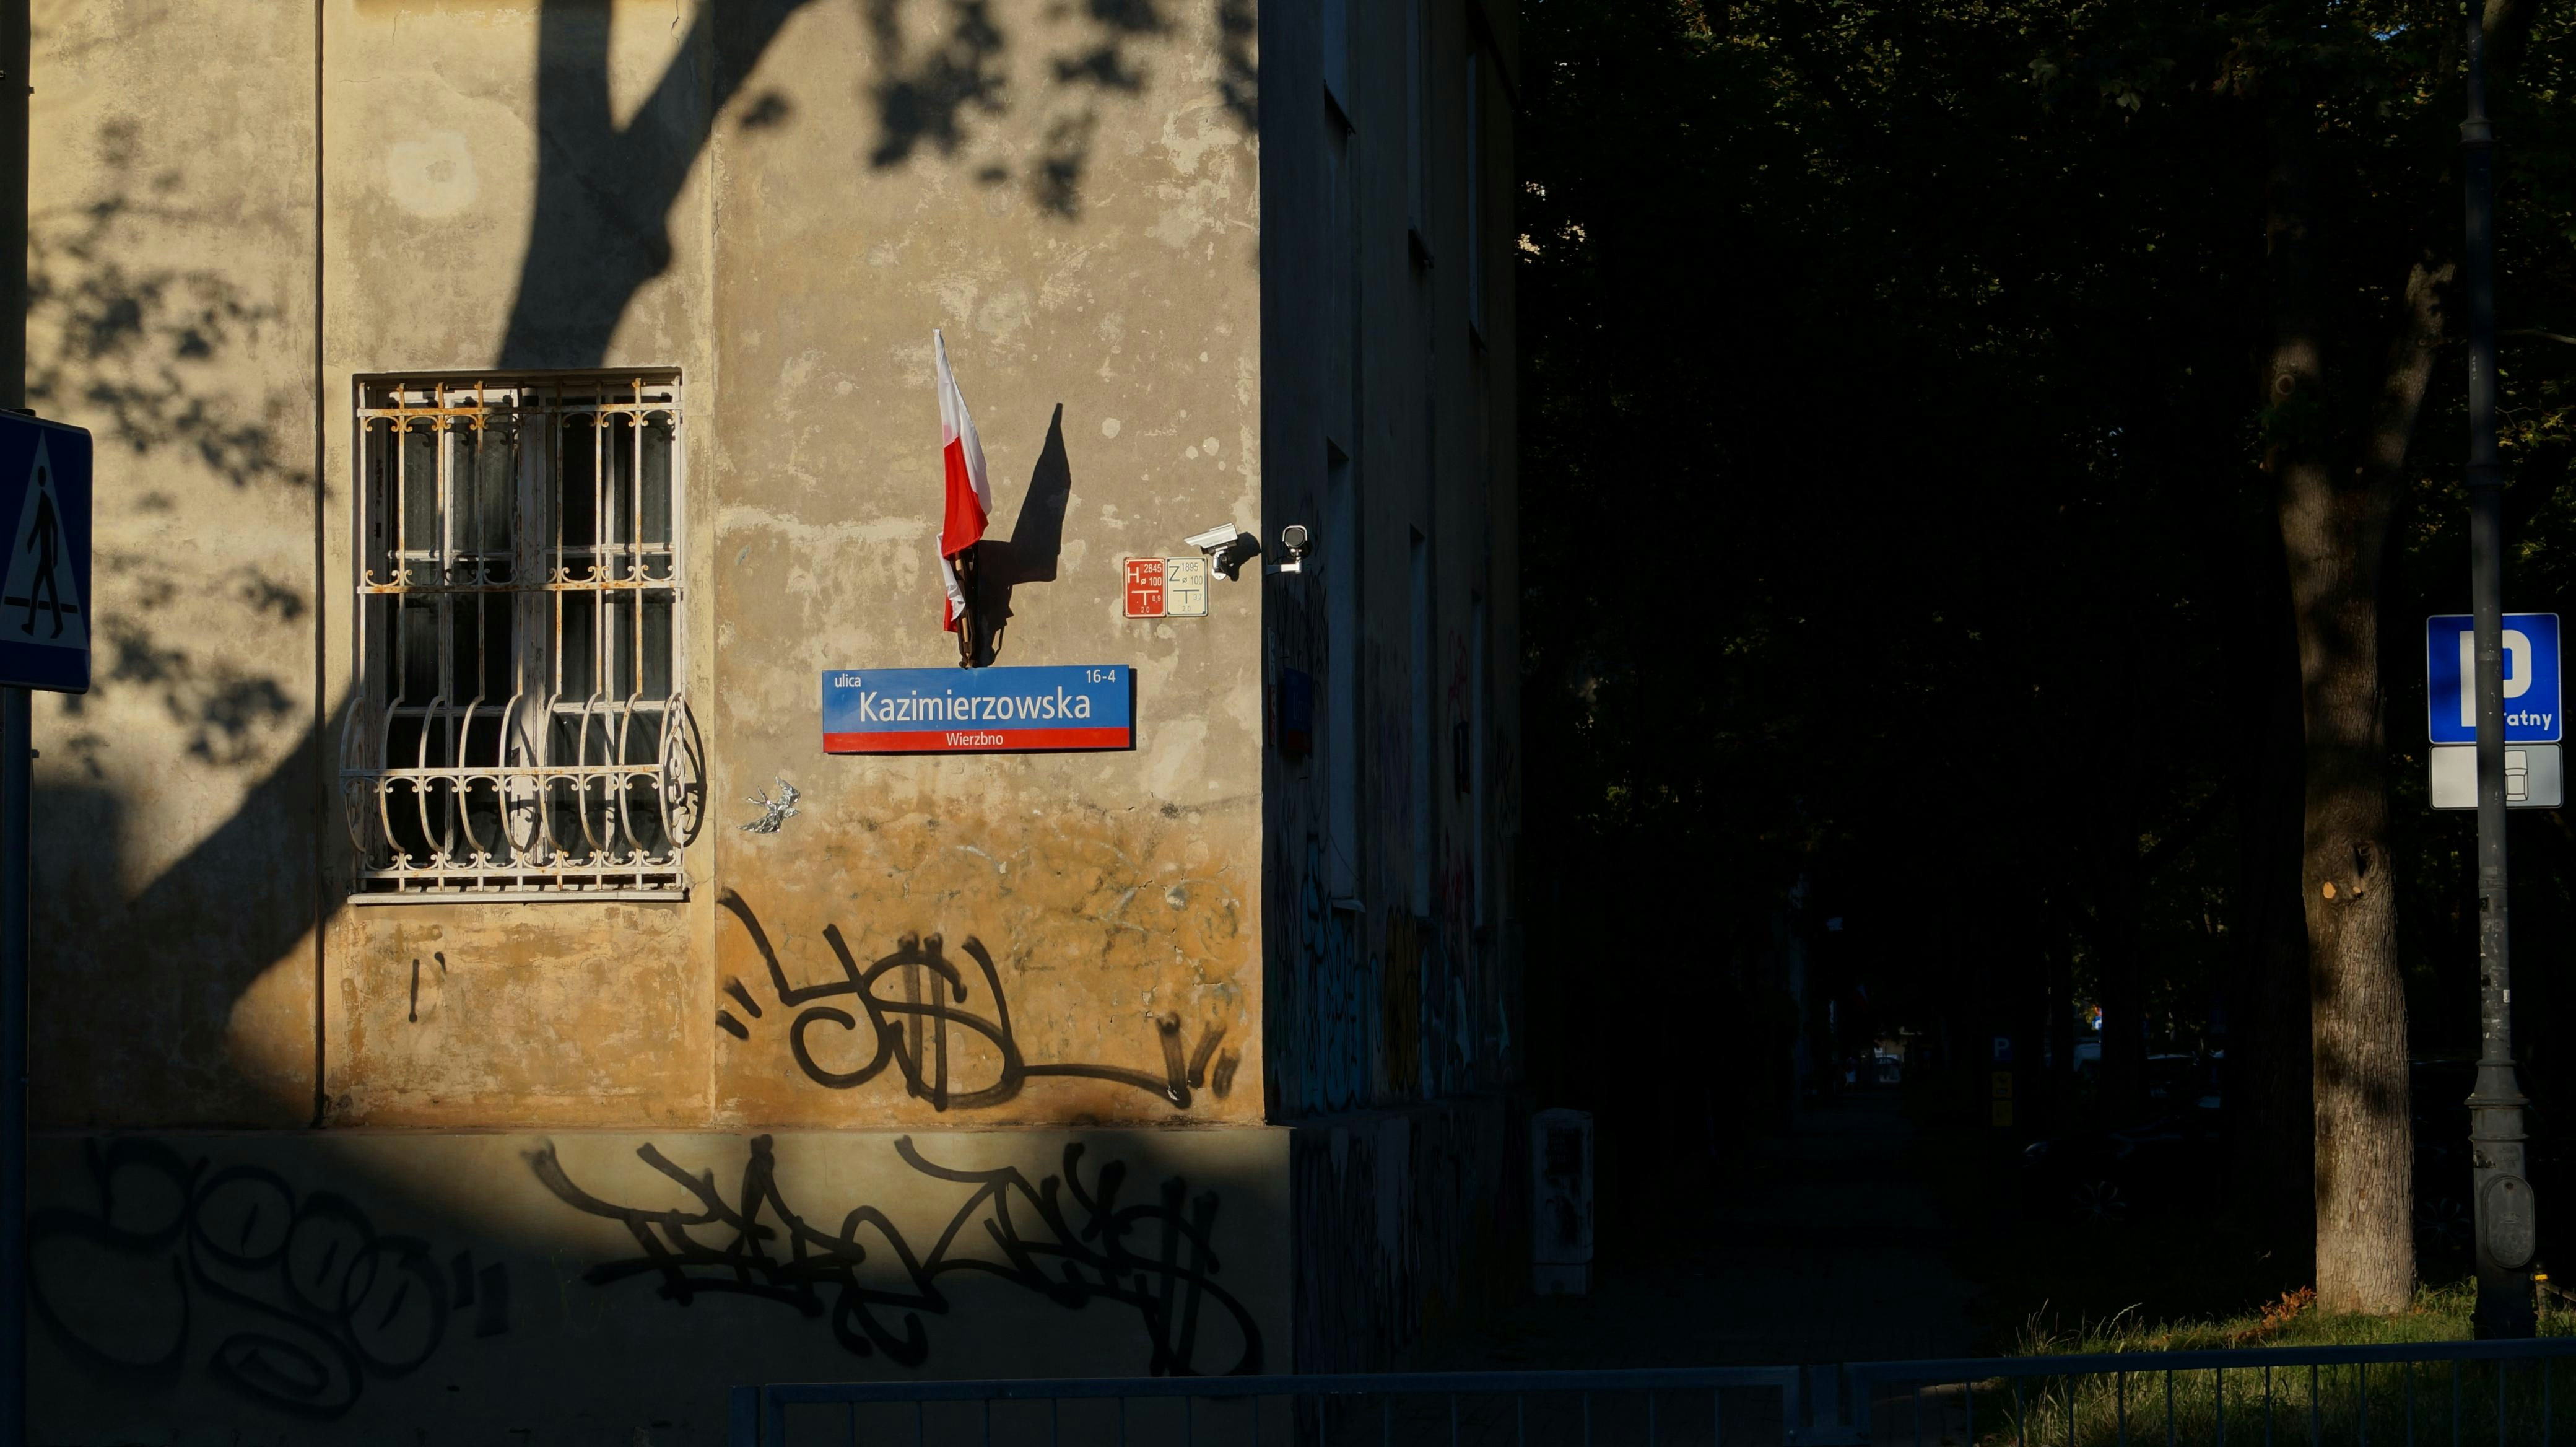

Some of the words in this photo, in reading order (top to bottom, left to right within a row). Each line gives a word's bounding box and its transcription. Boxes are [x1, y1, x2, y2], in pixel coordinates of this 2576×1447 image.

[1127, 566, 1139, 584] H
[1144, 563, 1162, 573] 2845
[1168, 566, 1180, 582] Z
[1181, 562, 1198, 572] 1895
[1149, 577, 1162, 587] 100
[1190, 575, 1203, 585] 100
[835, 673, 861, 688] ulica
[1086, 669, 1116, 683] 16-4
[860, 686, 1091, 722] Kazimierzowska
[946, 732, 1003, 746] Wierzbno
